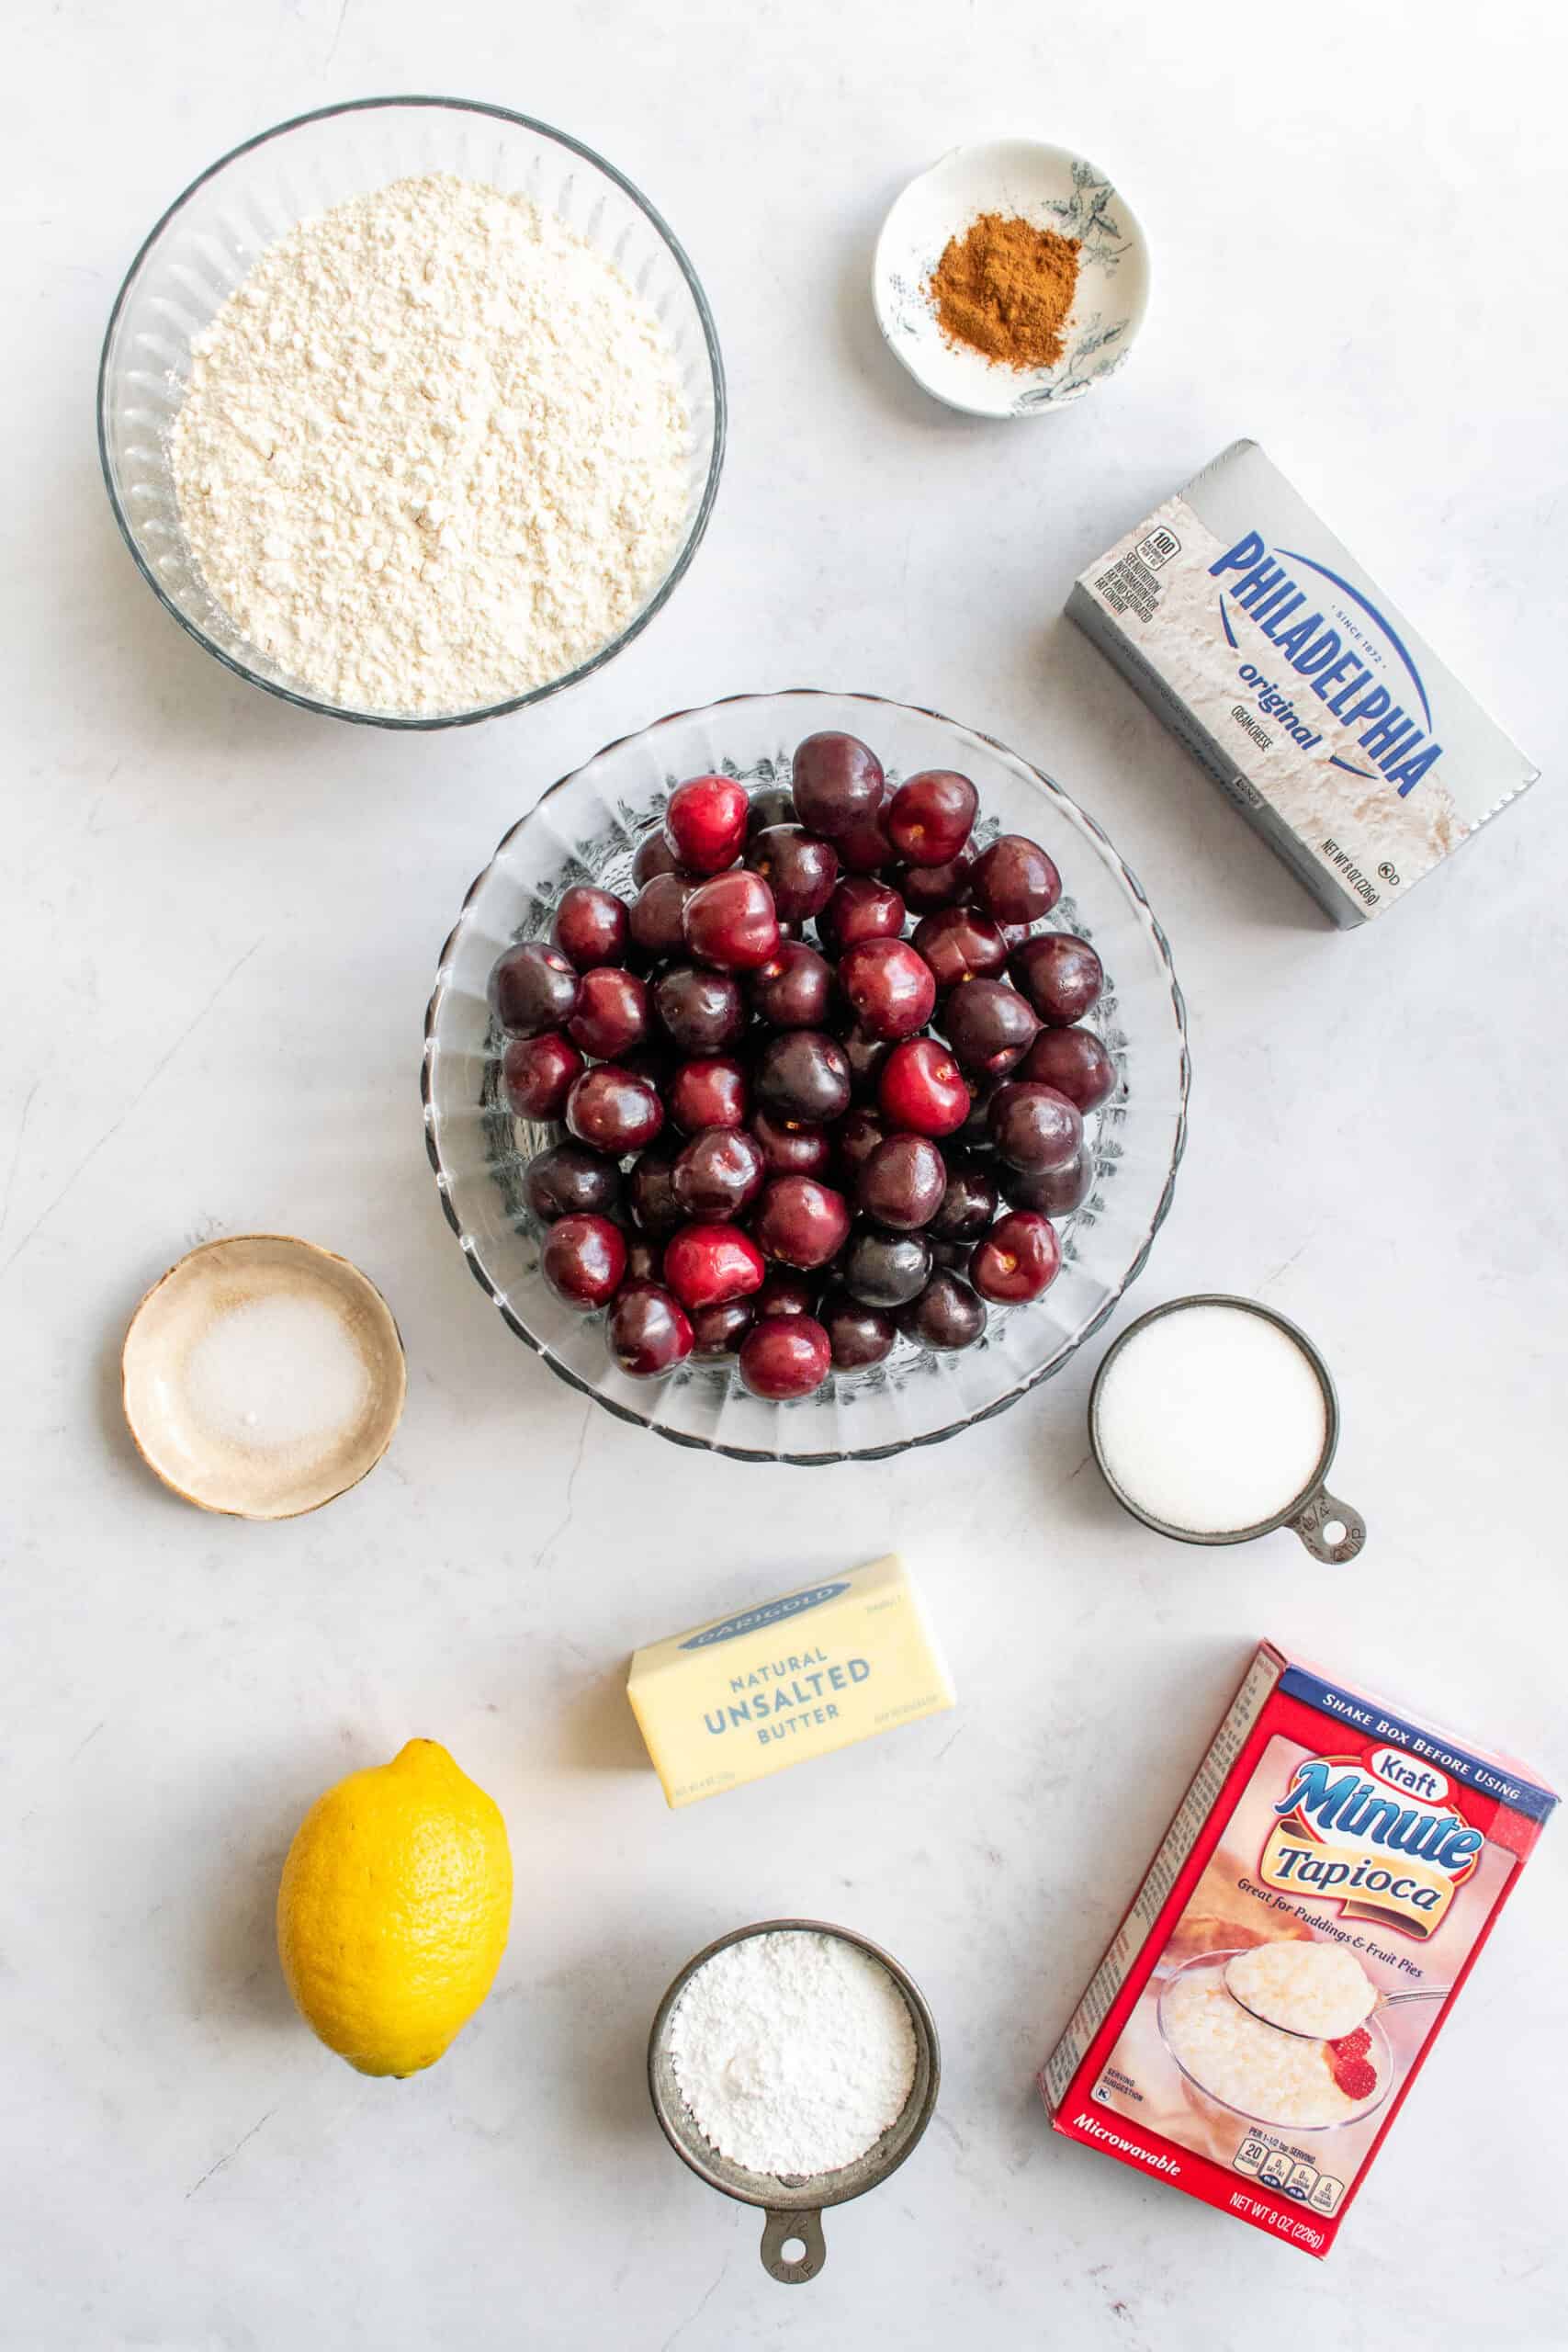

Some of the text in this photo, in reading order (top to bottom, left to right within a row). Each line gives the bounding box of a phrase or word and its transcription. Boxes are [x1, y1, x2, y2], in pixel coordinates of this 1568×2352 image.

[1152, 531, 1175, 555] 100
[1094, 577, 1127, 614] FAT CONTENT
[1104, 569, 1153, 623] FAT AND SATURATED
[1113, 560, 1158, 611] INFORMATION FOR
[1123, 552, 1160, 594] SEE NUTRITION
[1336, 610, 1382, 662] SINCE 1872
[1208, 530, 1443, 797] PHILADELPHIA
[1230, 705, 1254, 729] CREAM
[1247, 724, 1272, 751] CHEESE
[1238, 663, 1323, 751] original
[1321, 839, 1381, 907] NET WT 8 OZ (226g)
[728, 1646, 828, 1693] NATURAL
[704, 1658, 870, 1735] UNSALTED
[757, 1704, 840, 1745] BUTTER
[1322, 1692, 1520, 1800] SHAKE BOX BEFORE USING
[1378, 1755, 1440, 1799] Kraft
[1275, 1763, 1483, 1871] Minute
[1275, 1847, 1441, 1912] Tapioca
[1236, 1878, 1423, 1978] Great for Puddings & Fruit Pies
[1073, 2112, 1182, 2178] Microwavable
[1246, 2143, 1261, 2159] 20
[1248, 2127, 1262, 2138] PER
[1262, 2134, 1278, 2146] 1-1/2
[1229, 2192, 1325, 2249] NET WT 8 OZ (226g)
